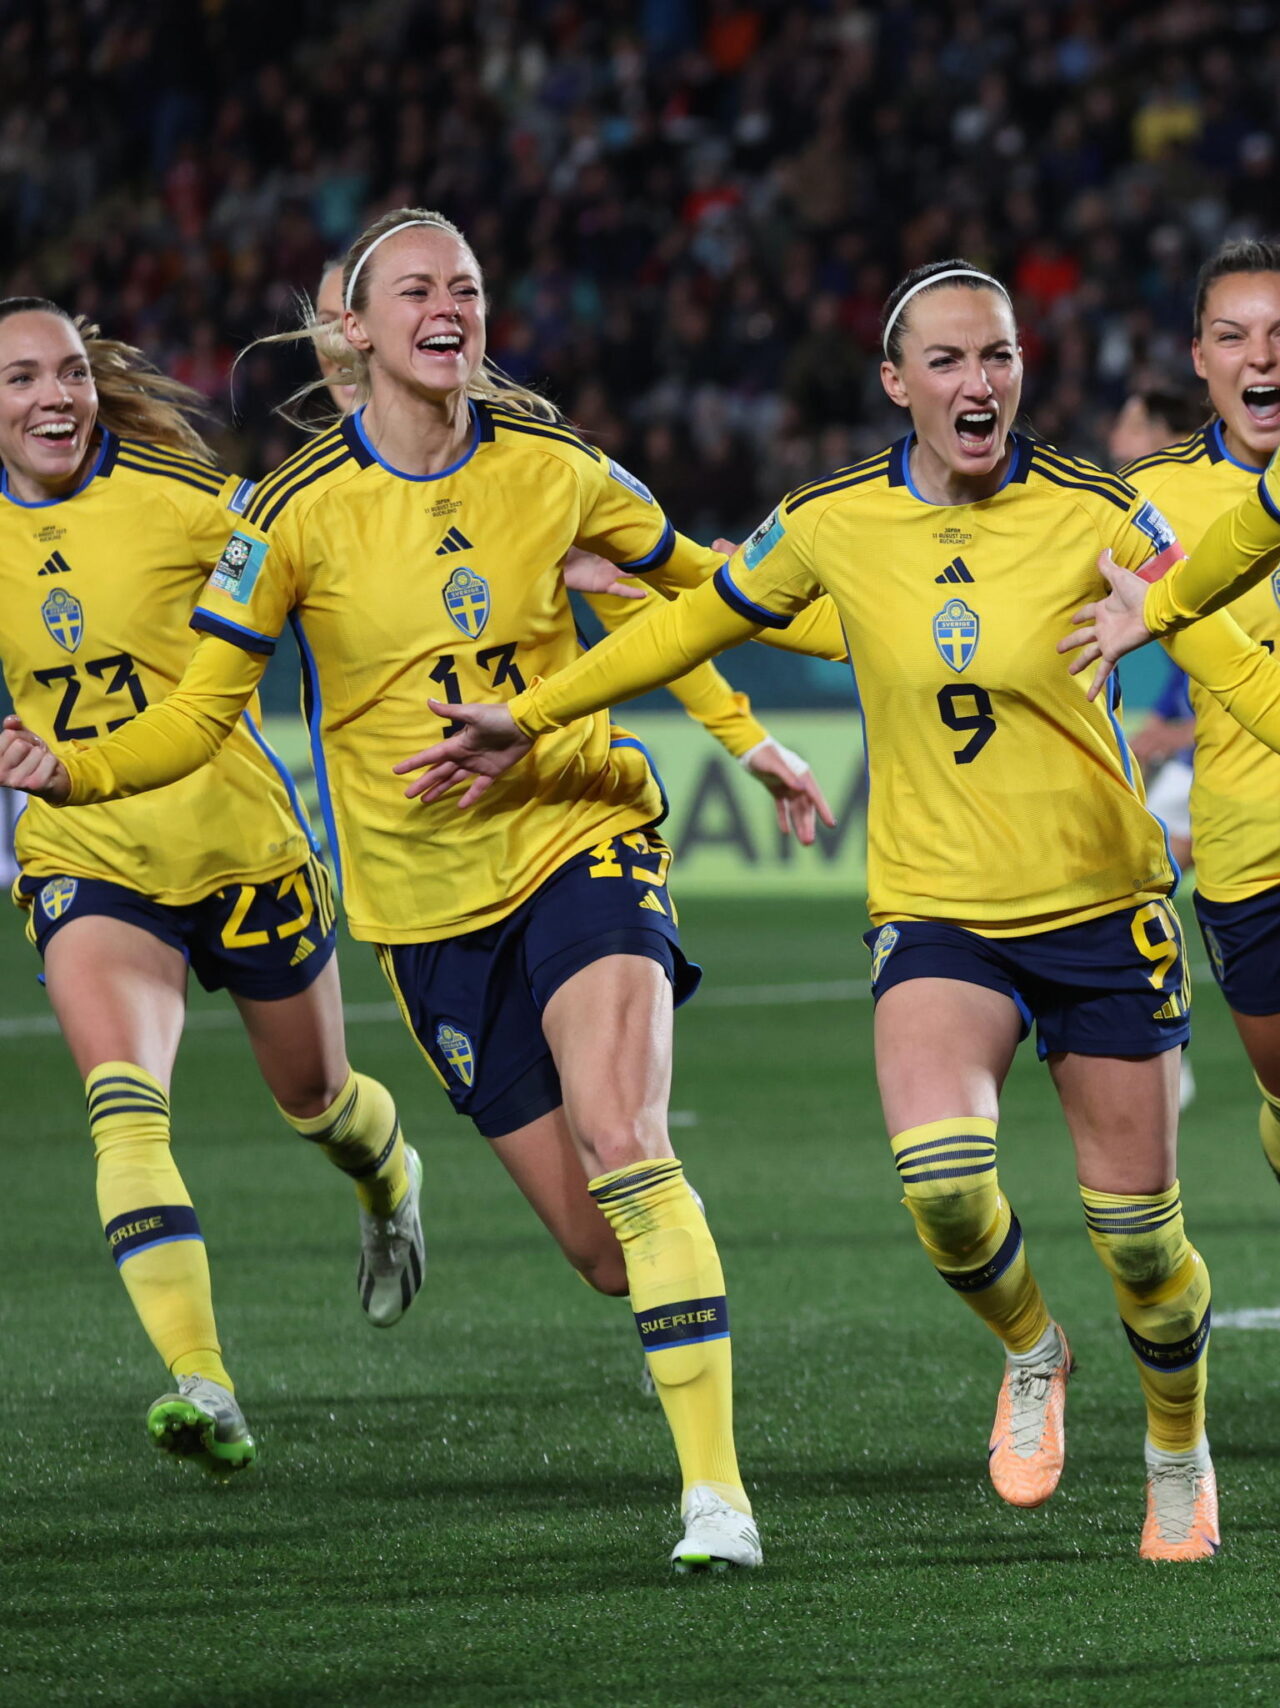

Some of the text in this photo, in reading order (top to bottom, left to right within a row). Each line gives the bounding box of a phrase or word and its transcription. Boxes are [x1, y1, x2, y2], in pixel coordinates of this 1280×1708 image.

[33, 653, 149, 742] 23
[937, 683, 997, 765] 9
[1130, 901, 1176, 989] 9
[108, 1216, 164, 1247] ERIGE
[641, 1308, 717, 1335] SVERIGE
